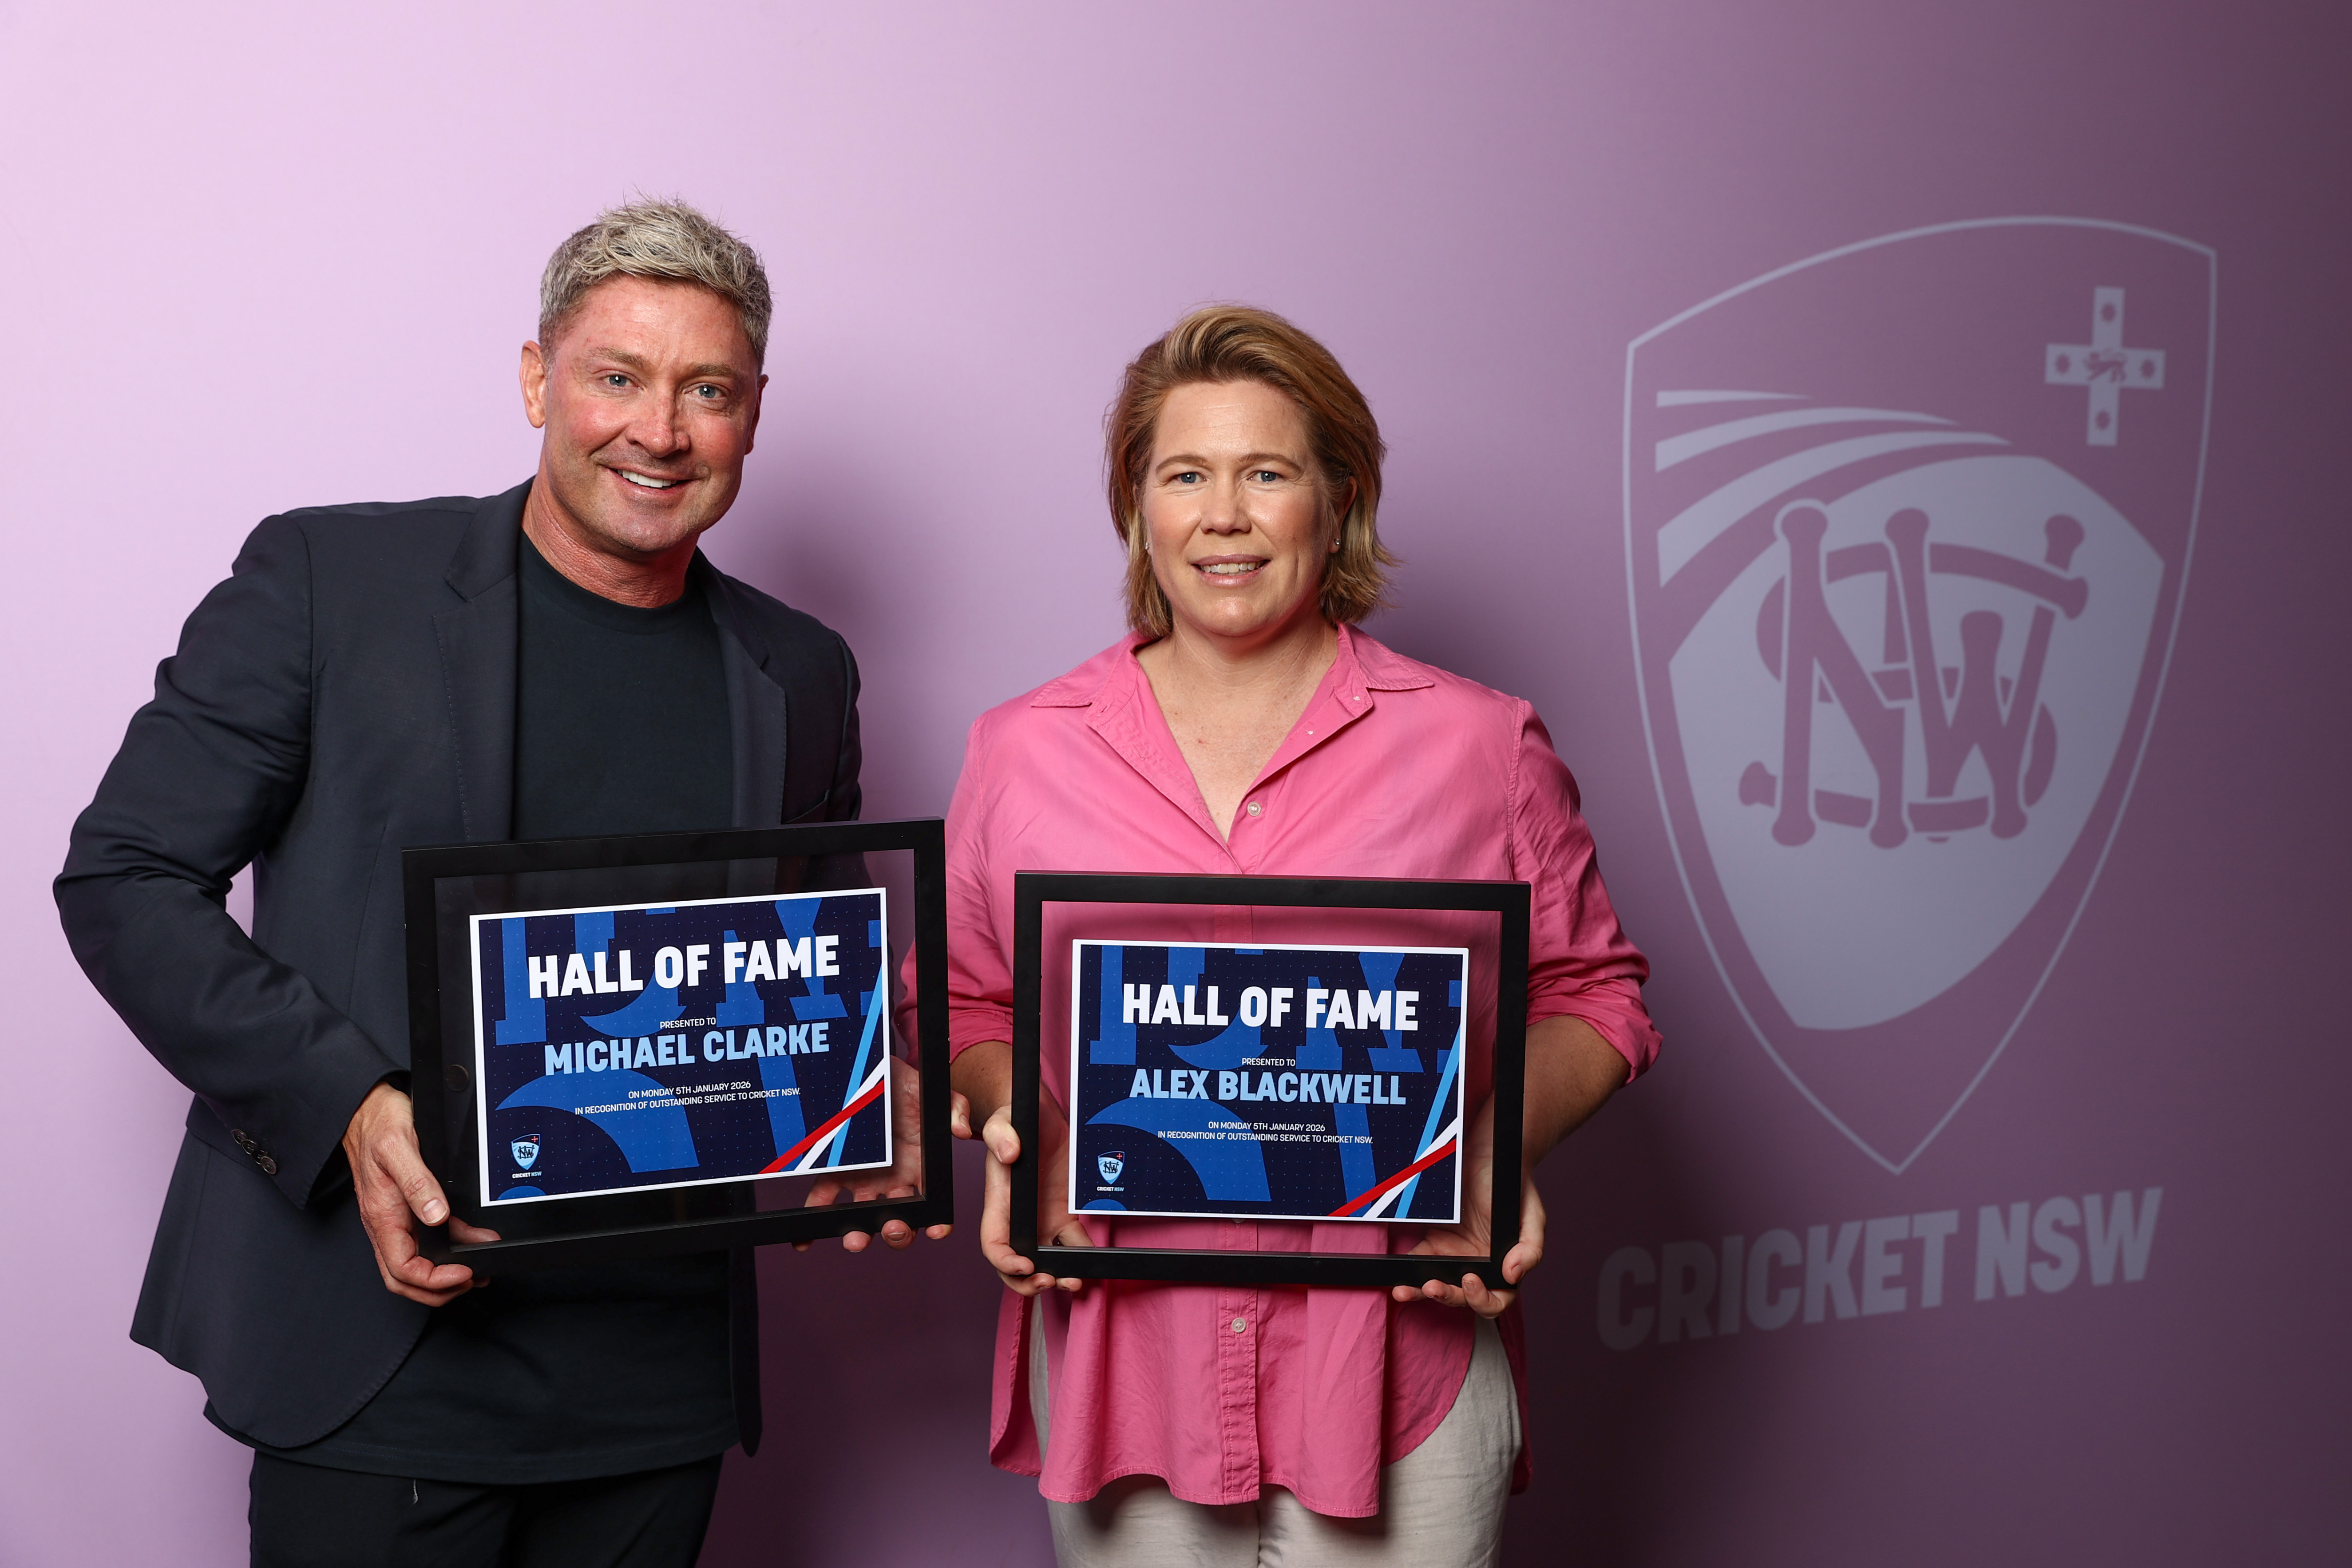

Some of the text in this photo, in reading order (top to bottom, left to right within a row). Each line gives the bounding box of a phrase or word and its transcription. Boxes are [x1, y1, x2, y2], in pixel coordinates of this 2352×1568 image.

[529, 935, 839, 998] HALL OF FAME
[660, 1018, 705, 1029] PRESENTED
[1123, 984, 1419, 1030] HALL OF FAME
[545, 1022, 829, 1075] MICHAEL CLARKE
[585, 1102, 636, 1114] RECOGNITION
[649, 1096, 703, 1108] OUTSTANDING
[705, 1093, 736, 1103] SERVICE
[749, 1089, 780, 1099] CRICKET
[641, 1088, 674, 1097] MONDAY
[693, 1083, 729, 1093] JANUARY
[731, 1081, 751, 1089] 2026
[1129, 1069, 1406, 1105] ALEX BLACKWELL
[1599, 1187, 2163, 1351] CRICKET NSW
